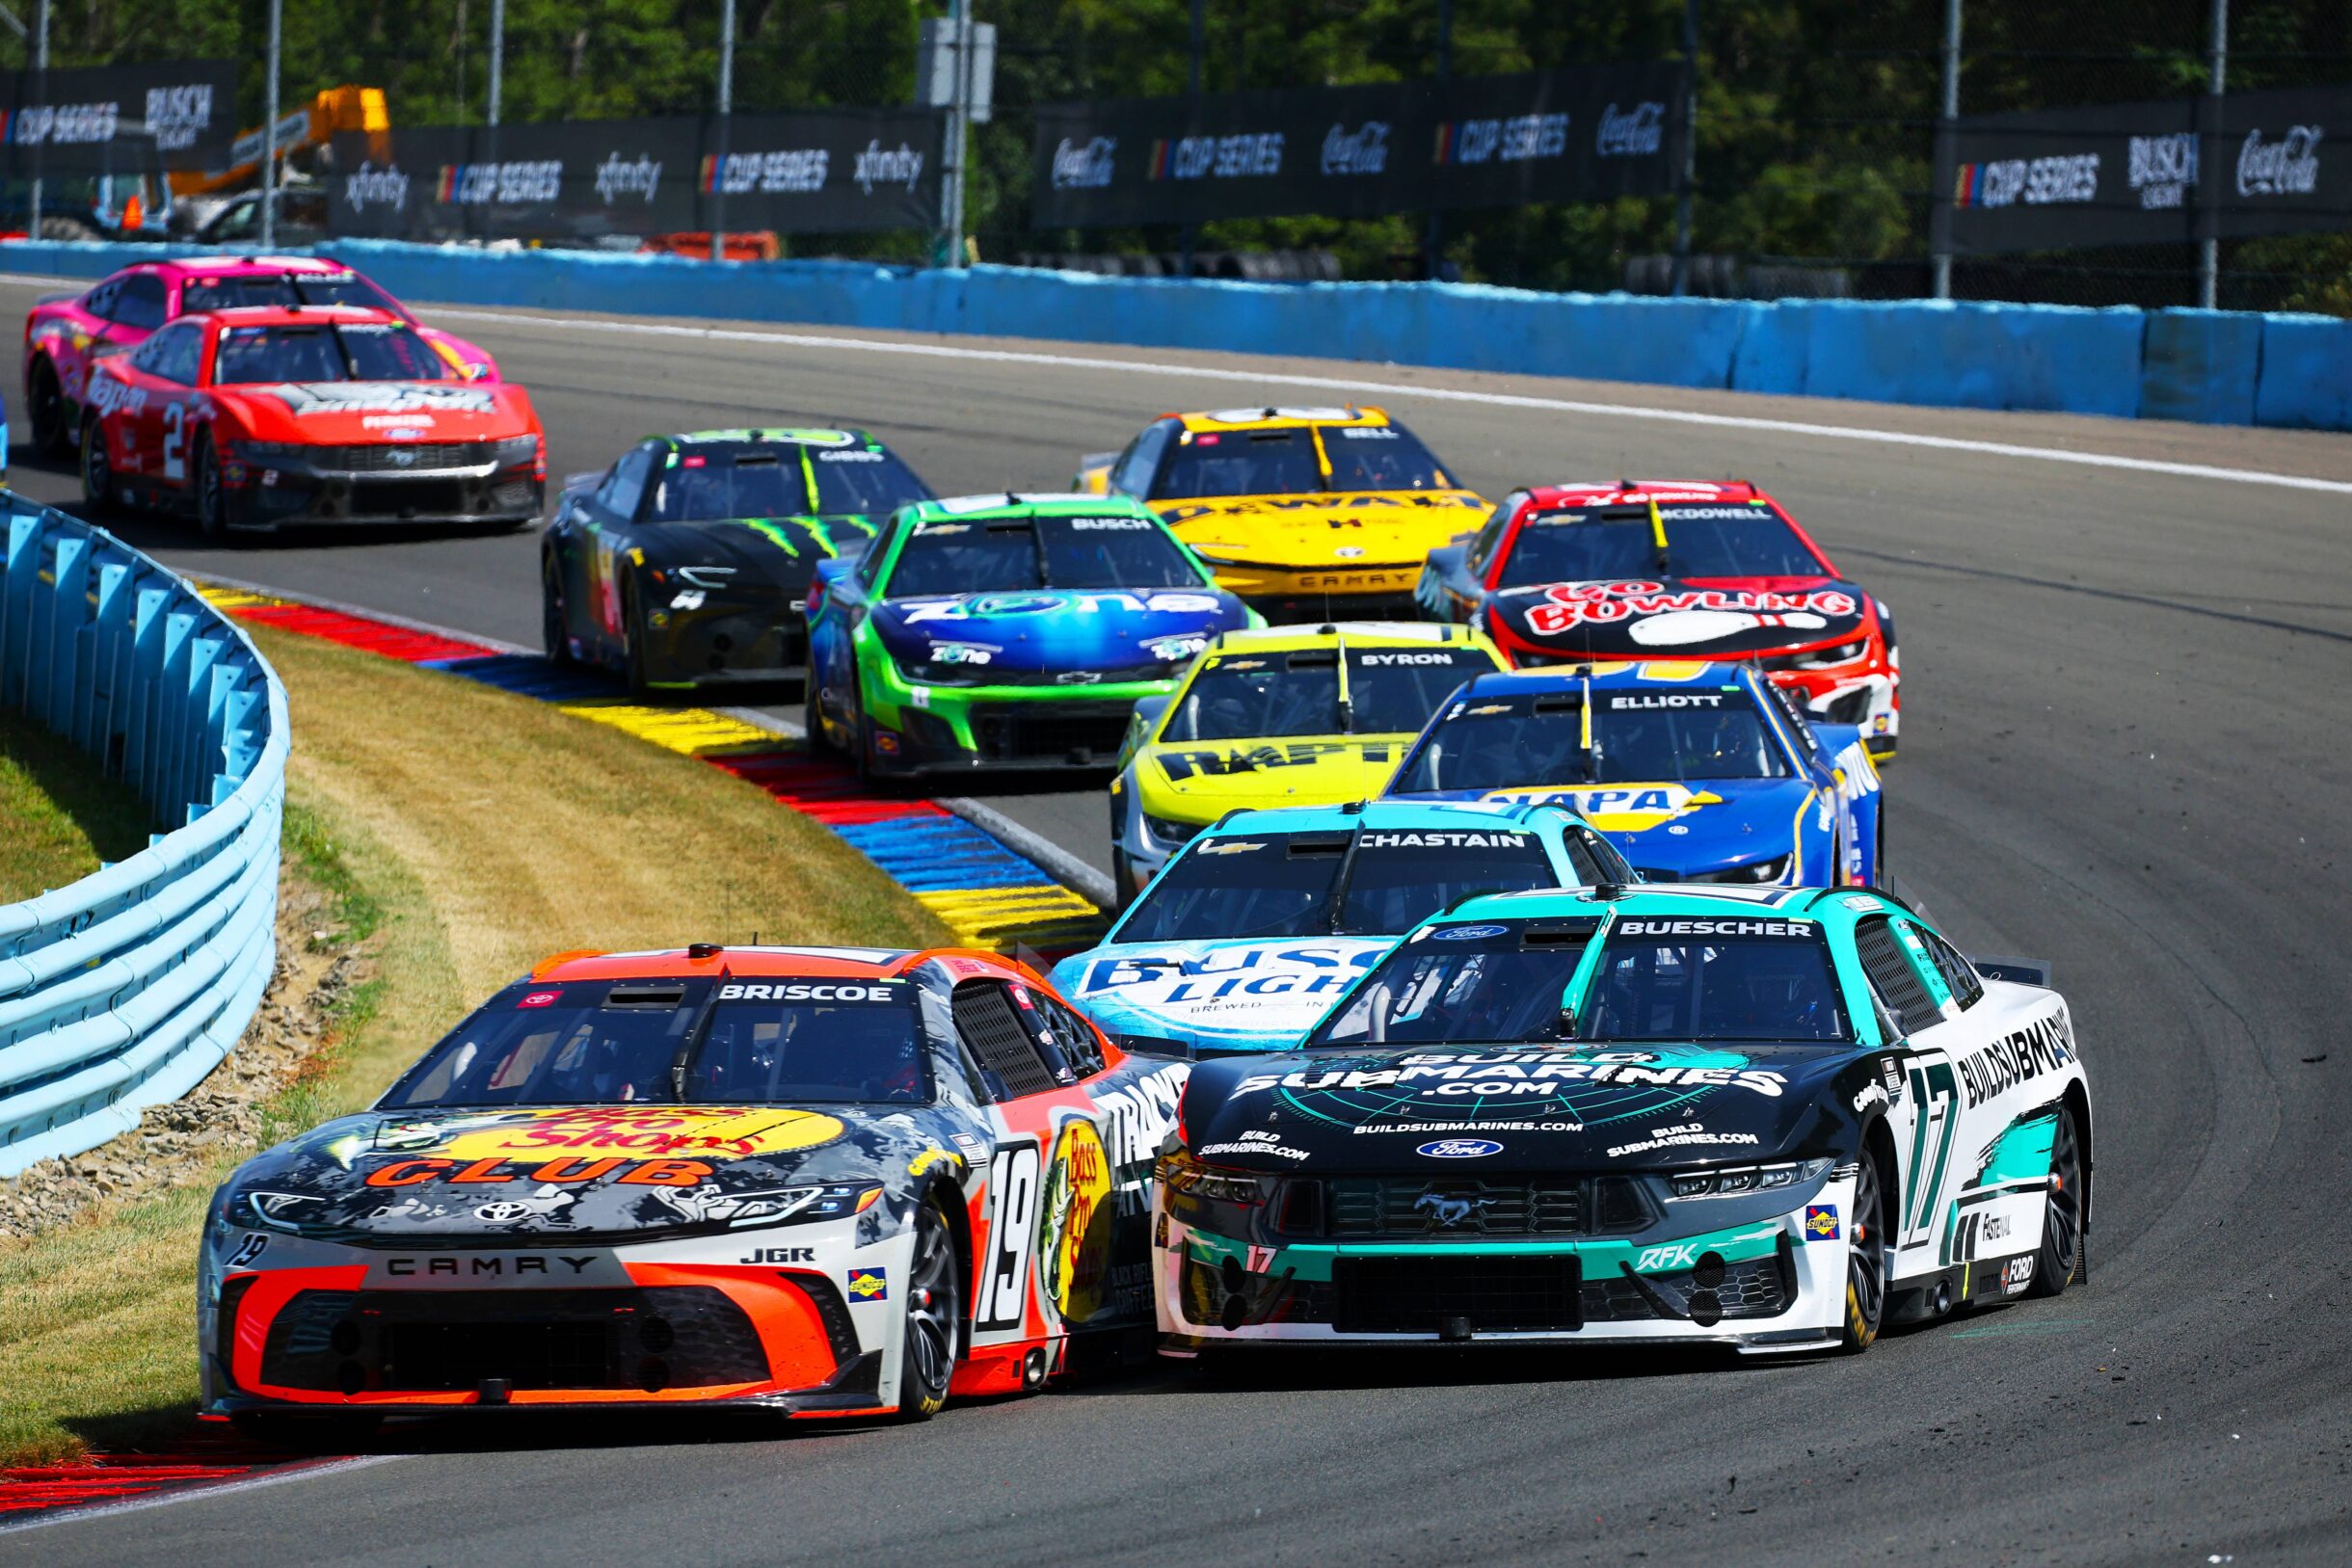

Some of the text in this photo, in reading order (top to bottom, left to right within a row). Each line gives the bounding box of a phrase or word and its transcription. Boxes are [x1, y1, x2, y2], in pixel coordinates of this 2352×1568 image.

[146, 84, 213, 133] BUSCH
[15, 102, 119, 145] CUP SERIES
[1458, 113, 1570, 163] CUP SERIES
[1174, 132, 1284, 179] CUP SERIES
[460, 160, 563, 202] CUP SERIES
[722, 148, 829, 193] CUP SERIES
[1982, 152, 2100, 208] CUP SERIES
[163, 402, 185, 480] 2
[1072, 518, 1152, 531] BUSCH
[1300, 572, 1414, 588] CAMRY
[1361, 653, 1453, 666] BYRON
[1611, 695, 1723, 710] ELLIOTT
[1359, 833, 1524, 849] CHASTAIN
[1620, 921, 1811, 937] BUESCHER
[1085, 947, 1398, 993] BUSC
[719, 984, 893, 1001] BRISCOE
[1164, 973, 1360, 1004] LIGH
[1190, 1001, 1262, 1014] BREWED
[1400, 1052, 1660, 1065] BUILD
[1422, 1081, 1559, 1096] .COM
[1239, 1129, 1281, 1142] BUILD
[1352, 1121, 1584, 1134] BUILDSUBMARINES.COM
[1651, 1123, 1704, 1138] BUILD
[1199, 1141, 1311, 1162] SUBMARINES.COM
[1431, 1140, 1490, 1156] Ford
[1607, 1132, 1759, 1157] SUBMARINES.COM
[1904, 1060, 1960, 1233] 17
[364, 1156, 716, 1186] CLUB
[1806, 1217, 1838, 1231] SUNOCO
[976, 1147, 1039, 1324] 19
[388, 1255, 600, 1276] CAMRY
[740, 1247, 817, 1263] JGR
[1246, 1245, 1276, 1273] 17
[1637, 1242, 1697, 1270] RFK
[2008, 1255, 2034, 1283] FORD
[849, 1278, 886, 1291] SUNOCO
